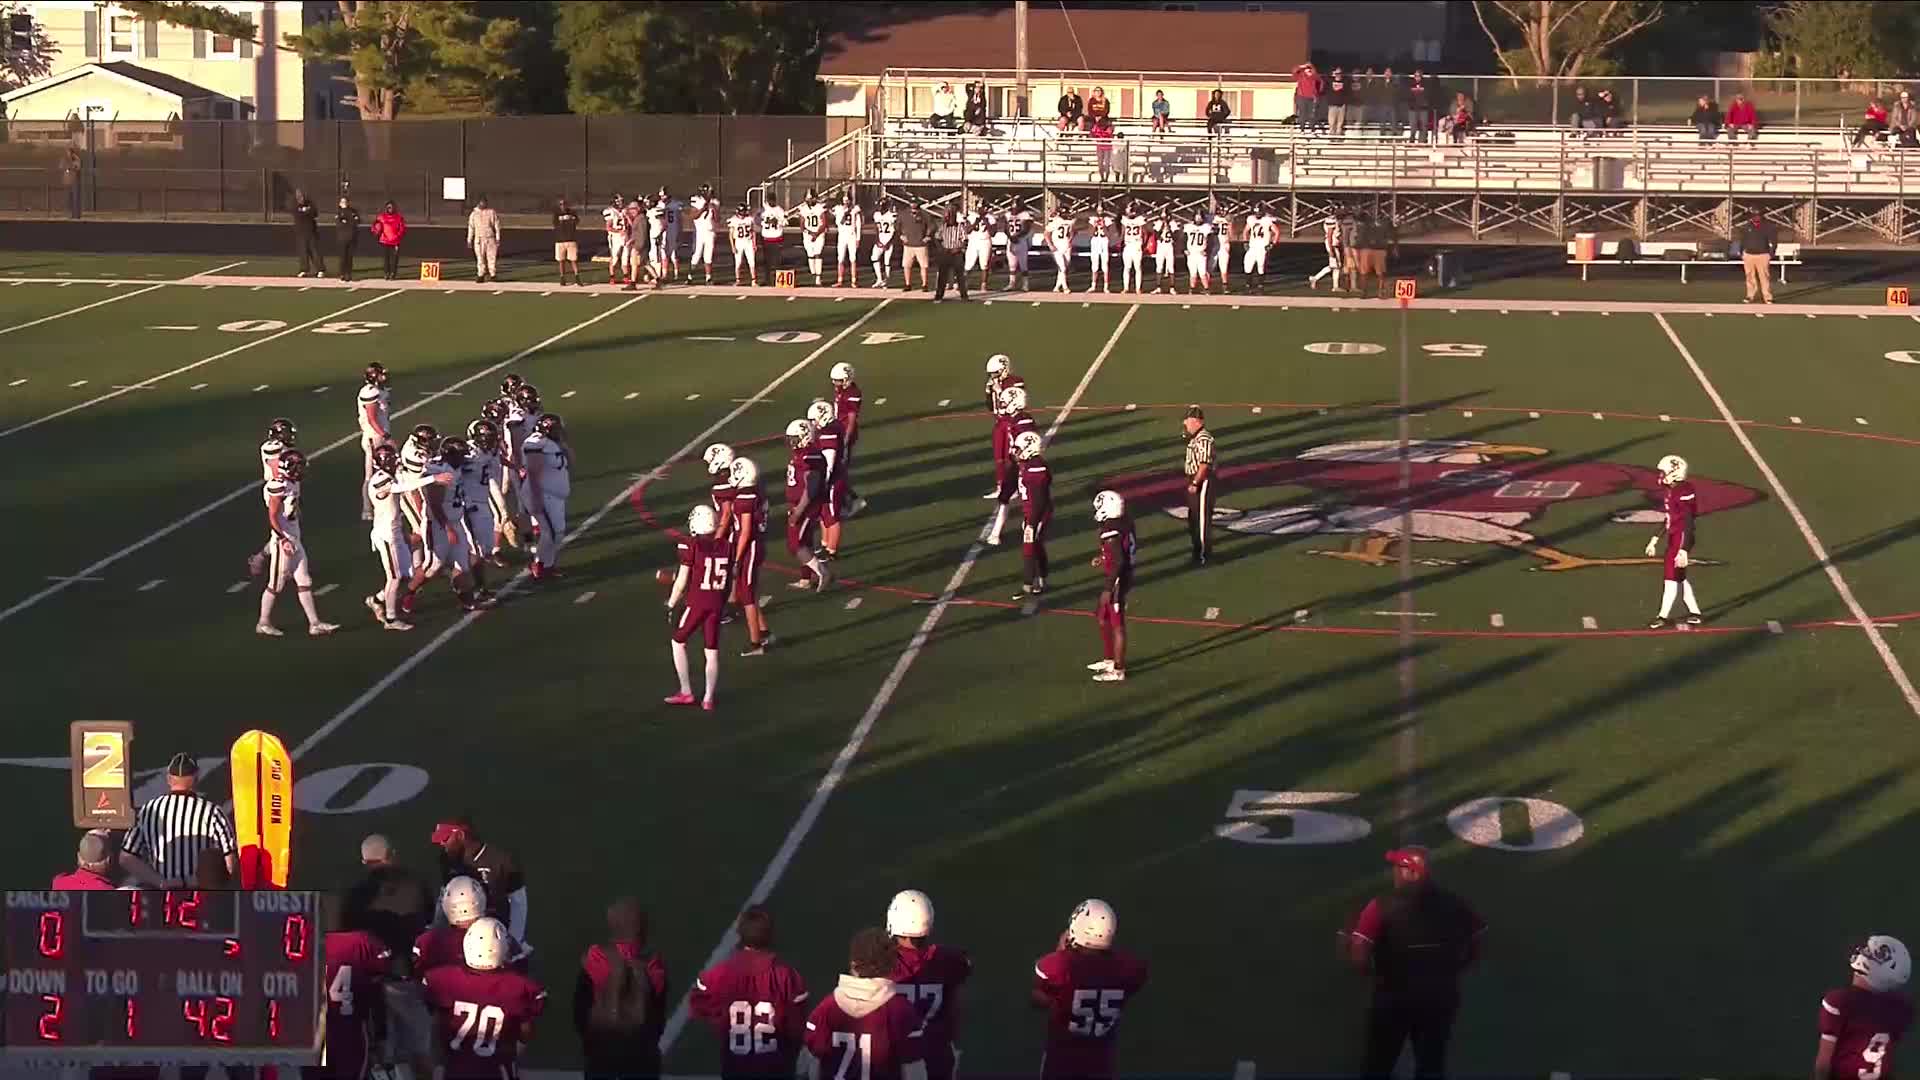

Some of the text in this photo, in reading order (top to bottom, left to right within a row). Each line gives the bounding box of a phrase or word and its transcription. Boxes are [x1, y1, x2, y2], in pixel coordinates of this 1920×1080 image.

[422, 264, 439, 279] 30
[776, 272, 793, 286] 40
[1398, 281, 1413, 297] 50
[1890, 290, 1907, 304] 40
[700, 557, 729, 591] 15
[83, 732, 125, 788] 2
[271, 794, 283, 824] DOWN
[1214, 789, 1585, 851] 50
[450, 1001, 506, 1057] 70
[729, 1000, 778, 1055] 82
[1068, 989, 1125, 1037] 55
[832, 1031, 872, 1080] 71
